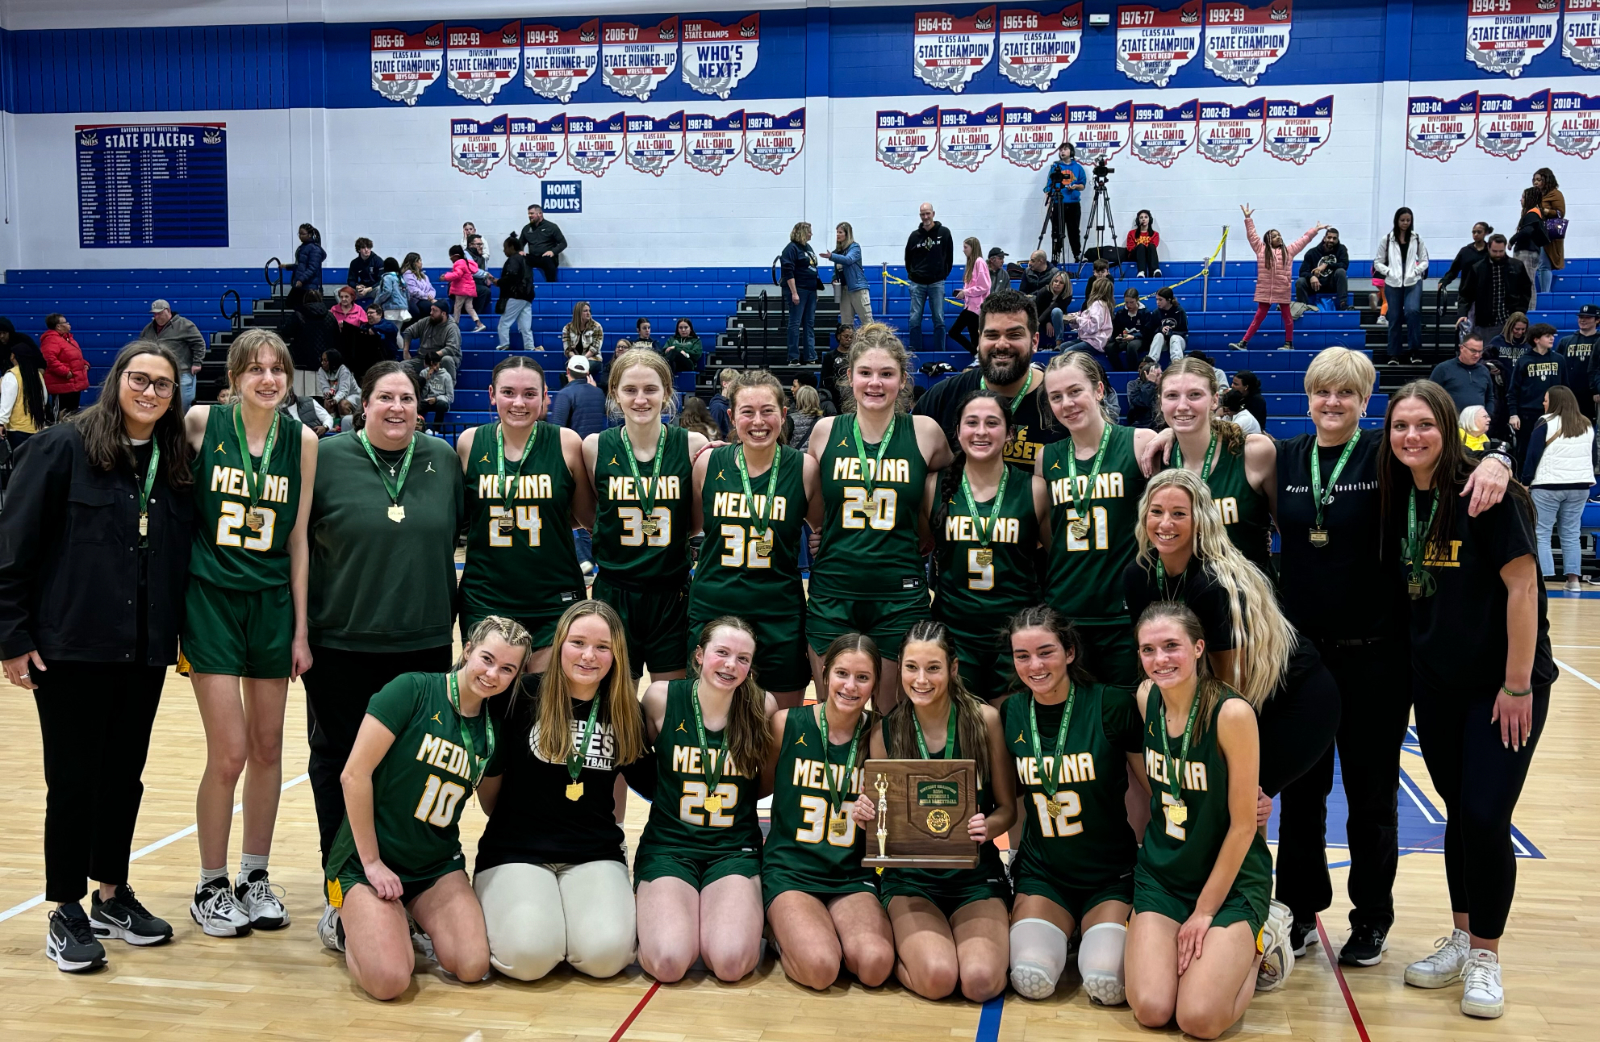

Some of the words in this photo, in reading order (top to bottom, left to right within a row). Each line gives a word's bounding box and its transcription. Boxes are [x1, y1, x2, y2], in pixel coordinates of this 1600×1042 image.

[1472, 0, 1510, 12] 1994-95
[1003, 15, 1037, 29] 1965-66
[1121, 11, 1154, 24] 1976-77
[1209, 9, 1244, 22] 1992-93
[918, 18, 952, 31] 1964-65
[1569, 23, 1596, 37] STATE
[450, 33, 479, 45] 1992-93
[527, 31, 558, 43] 1994-95
[606, 28, 638, 41] 2006-07
[1473, 27, 1499, 40] STATE
[1502, 25, 1551, 39] CHAMPION
[374, 35, 404, 47] 1965-66
[1122, 39, 1146, 52] STATE
[1150, 37, 1194, 51] CHAMPION
[1210, 37, 1235, 50] STATE
[1238, 35, 1284, 48] CHAMPION
[697, 45, 742, 61] WHO'S
[919, 45, 943, 58] STATE
[945, 44, 989, 57] CHAMPION
[1004, 43, 1029, 56] STATE
[1031, 41, 1075, 55] CHAMPION
[374, 60, 395, 72] STATE
[397, 58, 440, 71] CHAMPIONS
[450, 59, 471, 71] STATE
[473, 57, 517, 70] CHAMPIONS
[526, 56, 548, 69] STATE
[550, 55, 596, 68] RUNNER-UP
[604, 54, 626, 67] STATE
[629, 53, 674, 66] RUNNER-UP
[699, 62, 741, 78] NEXT?
[1412, 102, 1441, 113] 2003-04
[1482, 100, 1512, 111] 2007-08
[1554, 98, 1580, 108] 2010-11
[1071, 111, 1096, 121] 1997-98
[1136, 110, 1163, 120] 1999-00
[1202, 108, 1230, 118] 2002-03
[1269, 106, 1297, 116] 2002-03
[688, 120, 712, 129] 1987-88
[748, 118, 772, 128] 1987-88
[880, 116, 904, 126] 1990-91
[943, 115, 967, 124] 1991-92
[1006, 113, 1031, 123] 1997-98
[454, 124, 477, 133] 1979-80
[512, 123, 535, 132] 1979-80
[570, 122, 593, 131] 1982-83
[628, 121, 652, 130] 1987-88
[1277, 127, 1318, 136] ALL-OHIO
[1420, 123, 1462, 133] ALL-OHIO
[1490, 121, 1533, 131] ALL-OHIO
[951, 134, 989, 144] ALL-OHIO
[1014, 132, 1052, 142] ALL-OHIO
[1079, 131, 1117, 141] ALL-OHIO
[1144, 130, 1184, 139] ALL-OHIO
[1210, 128, 1250, 138] ALL-OHIO
[106, 134, 139, 148] STATE
[143, 134, 194, 147] PLACERS
[462, 142, 496, 152] ALL-OHIO
[520, 142, 554, 151] ALL-OHIO
[578, 141, 613, 150] ALL-OHIO
[637, 140, 672, 149] ALL-OHIO
[696, 139, 732, 148] ALL-OHIO
[756, 138, 792, 147] ALL-OHIO
[888, 135, 926, 146] ALL-OHIO
[547, 185, 575, 194] HOME
[544, 198, 580, 209] ADULTS
[833, 457, 909, 483] MEDINA
[211, 465, 288, 503] MEDNA
[479, 474, 552, 499] MEDINA
[1286, 485, 1308, 493] Medina
[1335, 481, 1378, 492] Basketball
[713, 492, 786, 521] MEDINA
[842, 487, 897, 531] 20
[216, 501, 276, 552] 23
[490, 505, 542, 547] 24
[618, 507, 671, 547] 33
[1067, 506, 1108, 551] 21
[721, 524, 774, 568] 32
[968, 548, 994, 591] 5
[570, 720, 614, 736] EDNA
[572, 732, 614, 757] EES
[416, 733, 484, 784] MEDI
[672, 745, 755, 776] MEDN
[1016, 752, 1096, 785] MEDINA
[414, 774, 465, 828] 10
[680, 781, 738, 827] 22
[1032, 790, 1083, 837] 12
[1162, 791, 1186, 841] 2
[796, 795, 856, 848] 30
